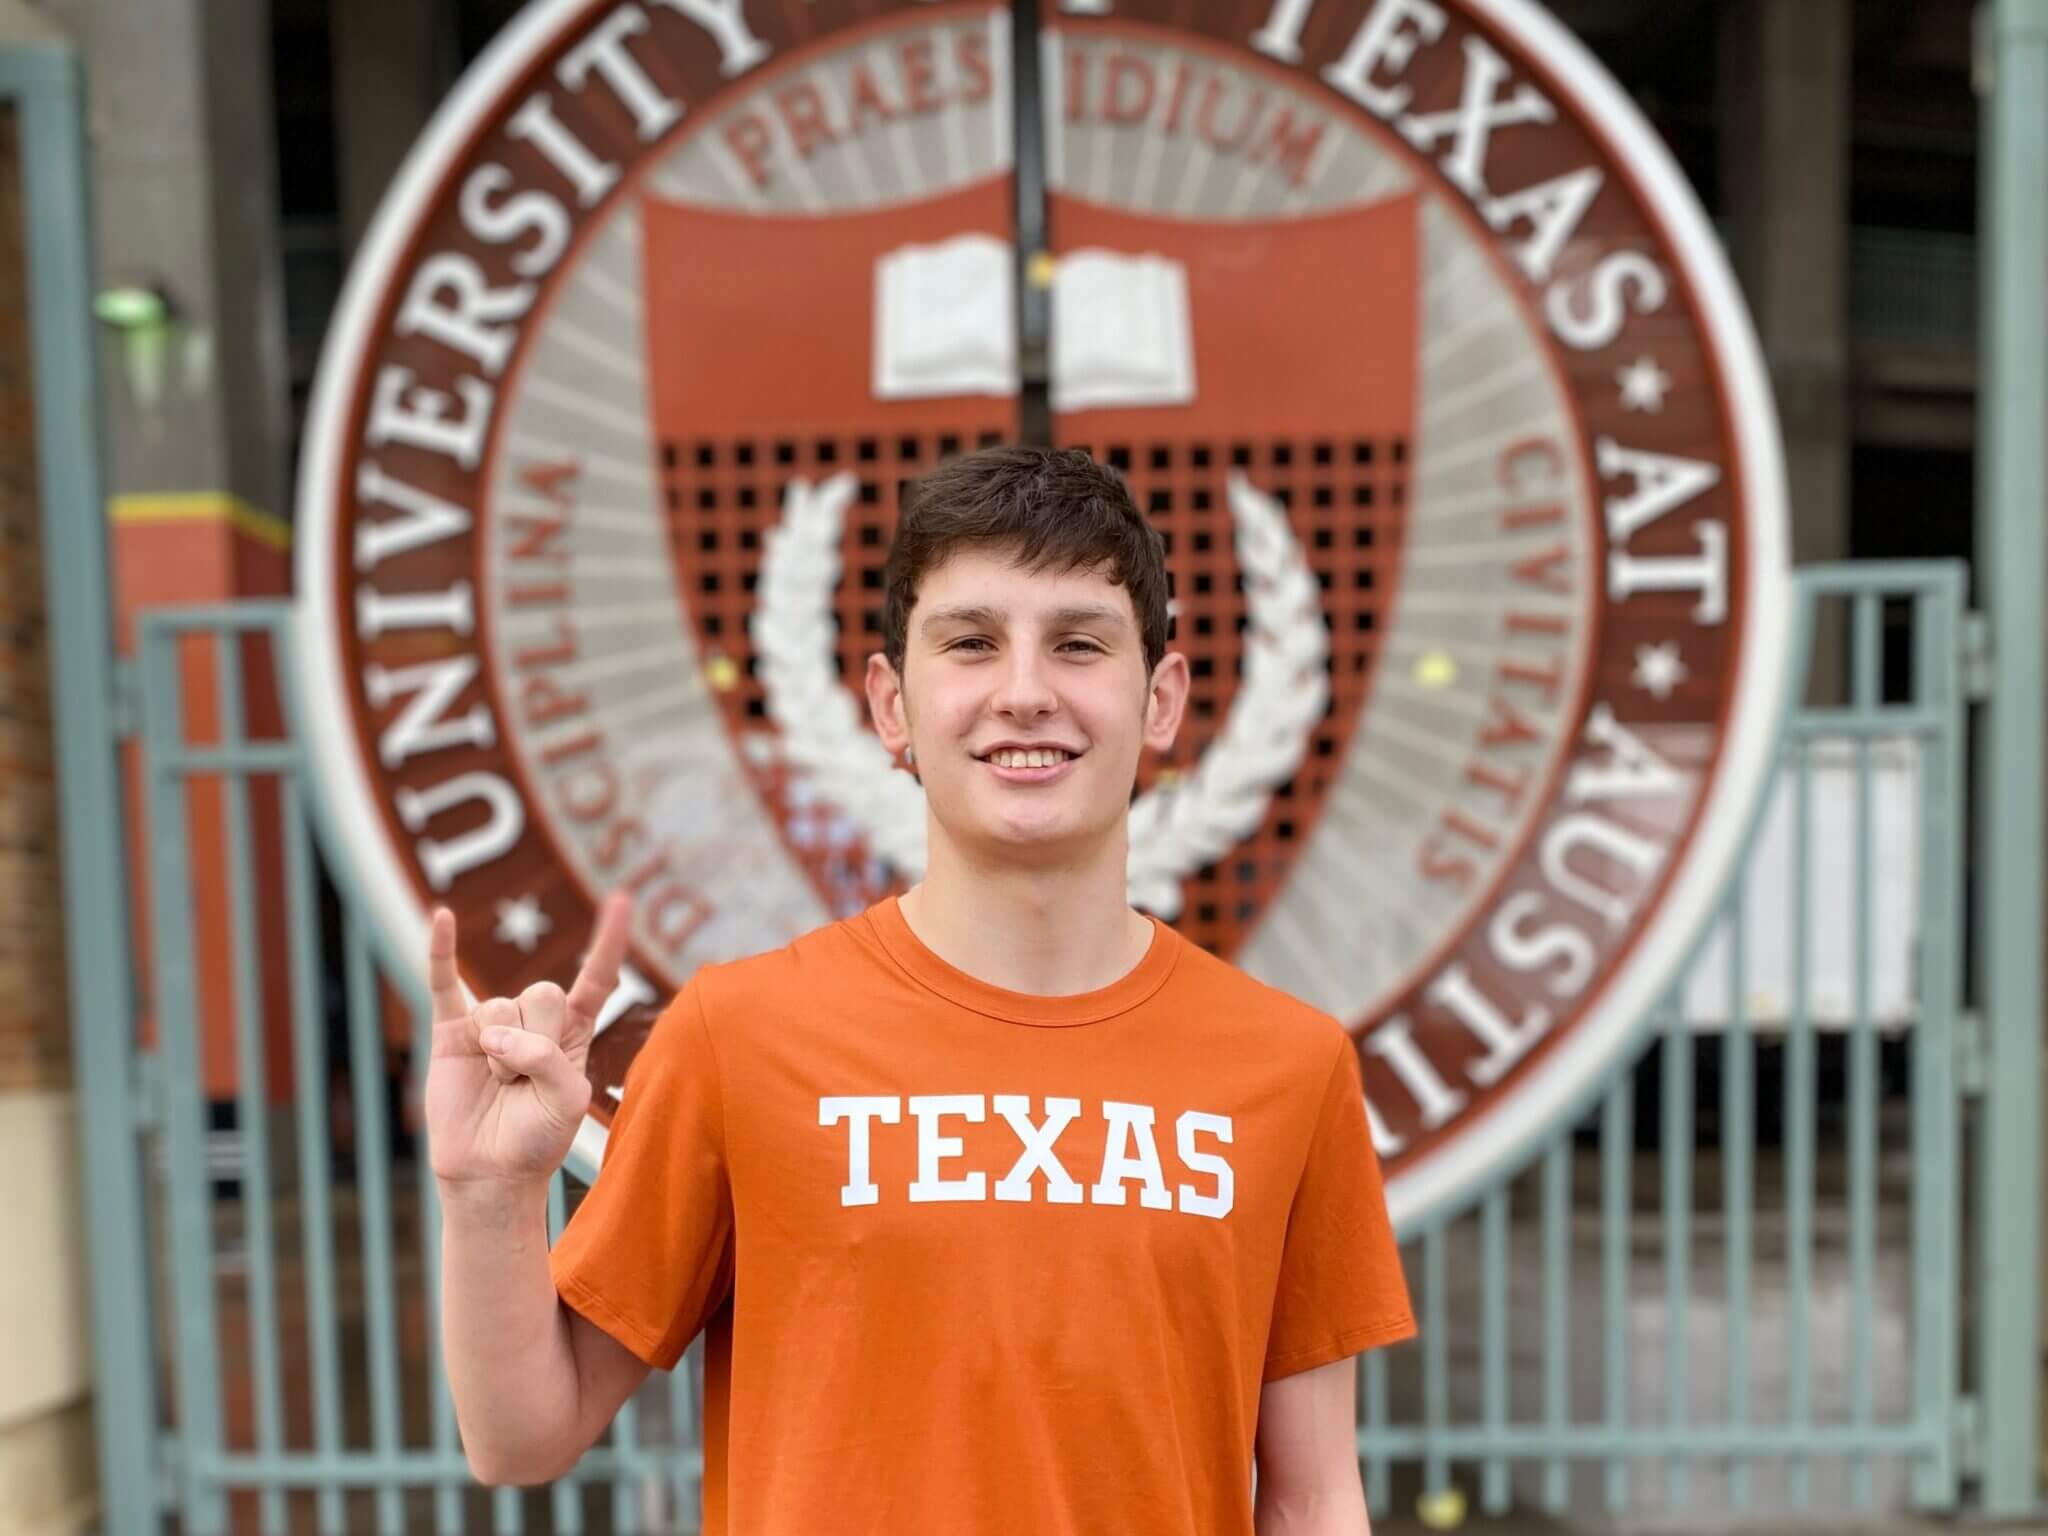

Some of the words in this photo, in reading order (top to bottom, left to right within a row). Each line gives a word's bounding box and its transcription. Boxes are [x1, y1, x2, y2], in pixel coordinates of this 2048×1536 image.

[722, 33, 992, 189] PRAES
[354, 0, 773, 891] UNIVERSITY
[1598, 436, 1729, 625] AT
[1416, 436, 1574, 890] CIVITATIS
[506, 454, 718, 955] DISCIPLINA
[818, 1094, 1235, 1220] TEXAS
